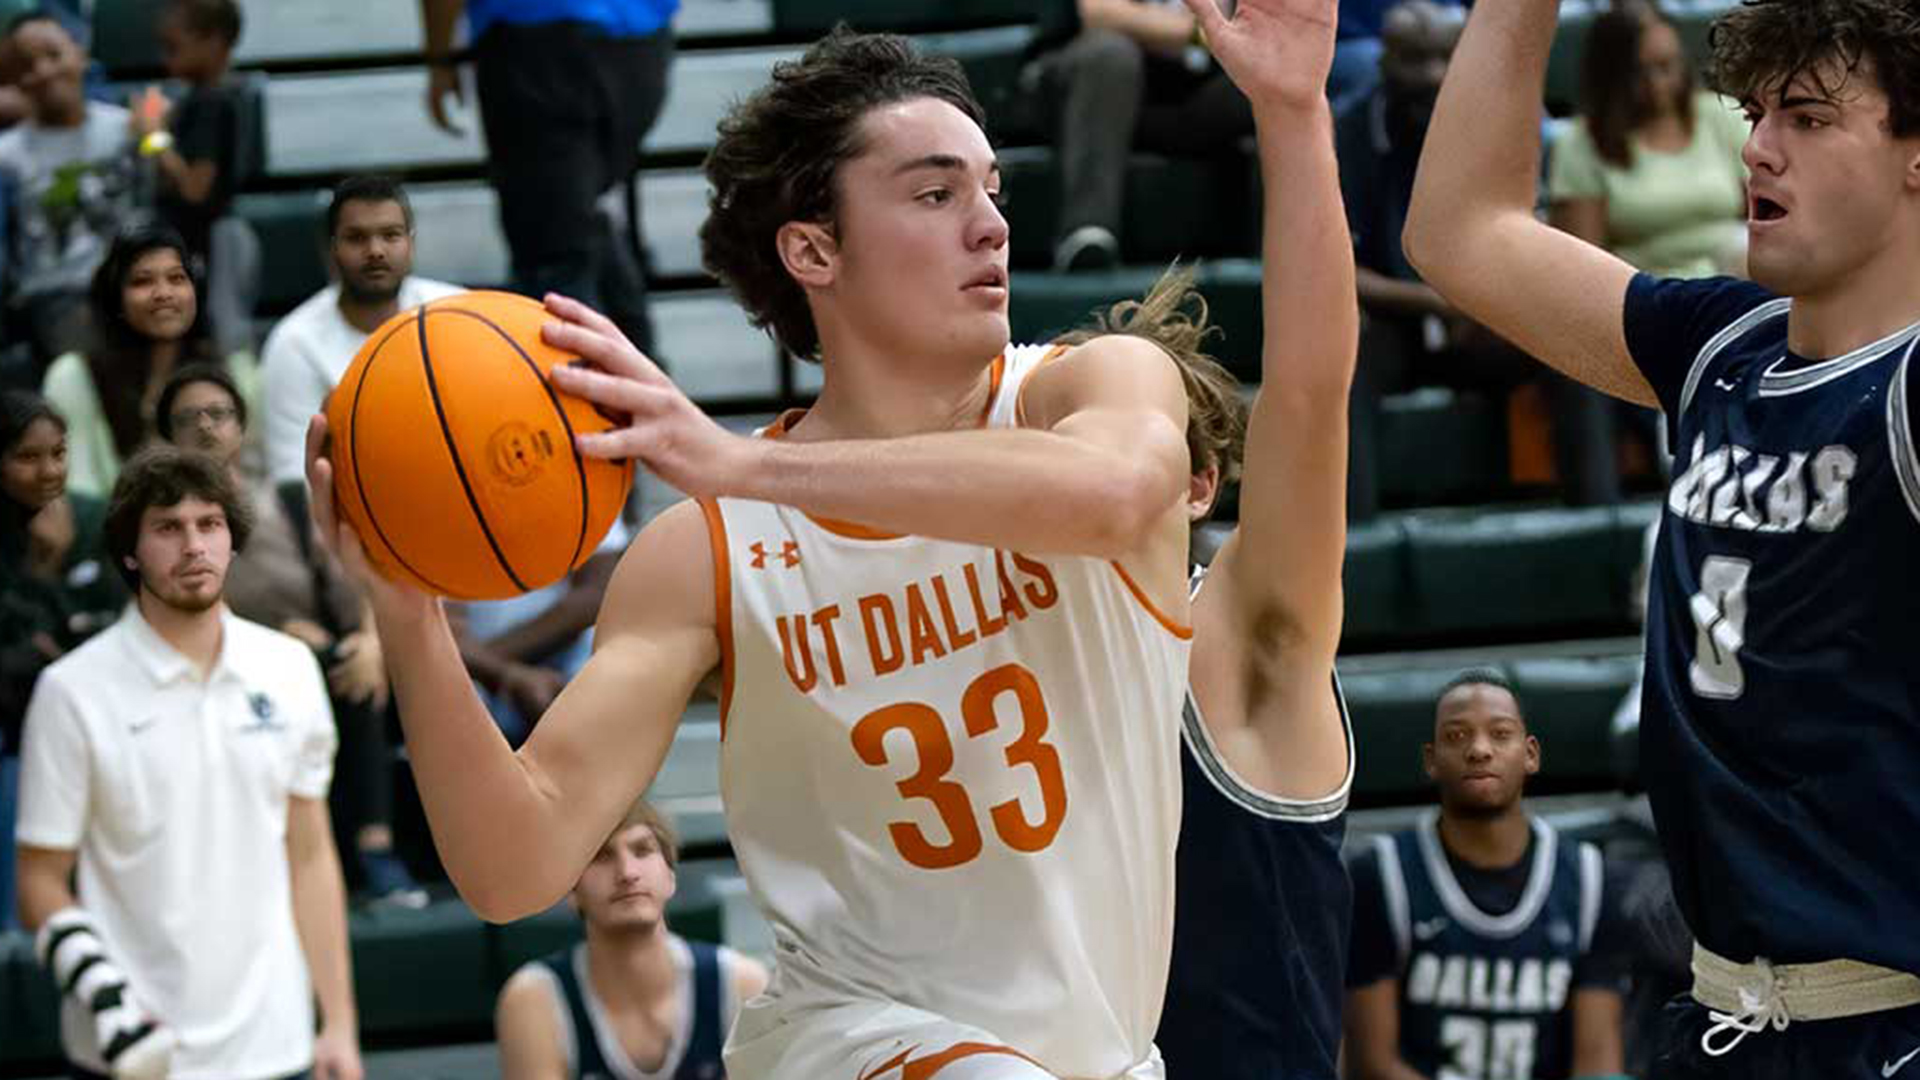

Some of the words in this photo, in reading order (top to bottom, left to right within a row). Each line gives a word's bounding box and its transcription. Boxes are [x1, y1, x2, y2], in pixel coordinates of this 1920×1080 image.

[776, 604, 847, 694] UT
[858, 548, 1059, 676] DALLAS
[850, 663, 1068, 870] 33
[1407, 953, 1573, 1012] DALLAS
[1436, 1015, 1538, 1080] 30
